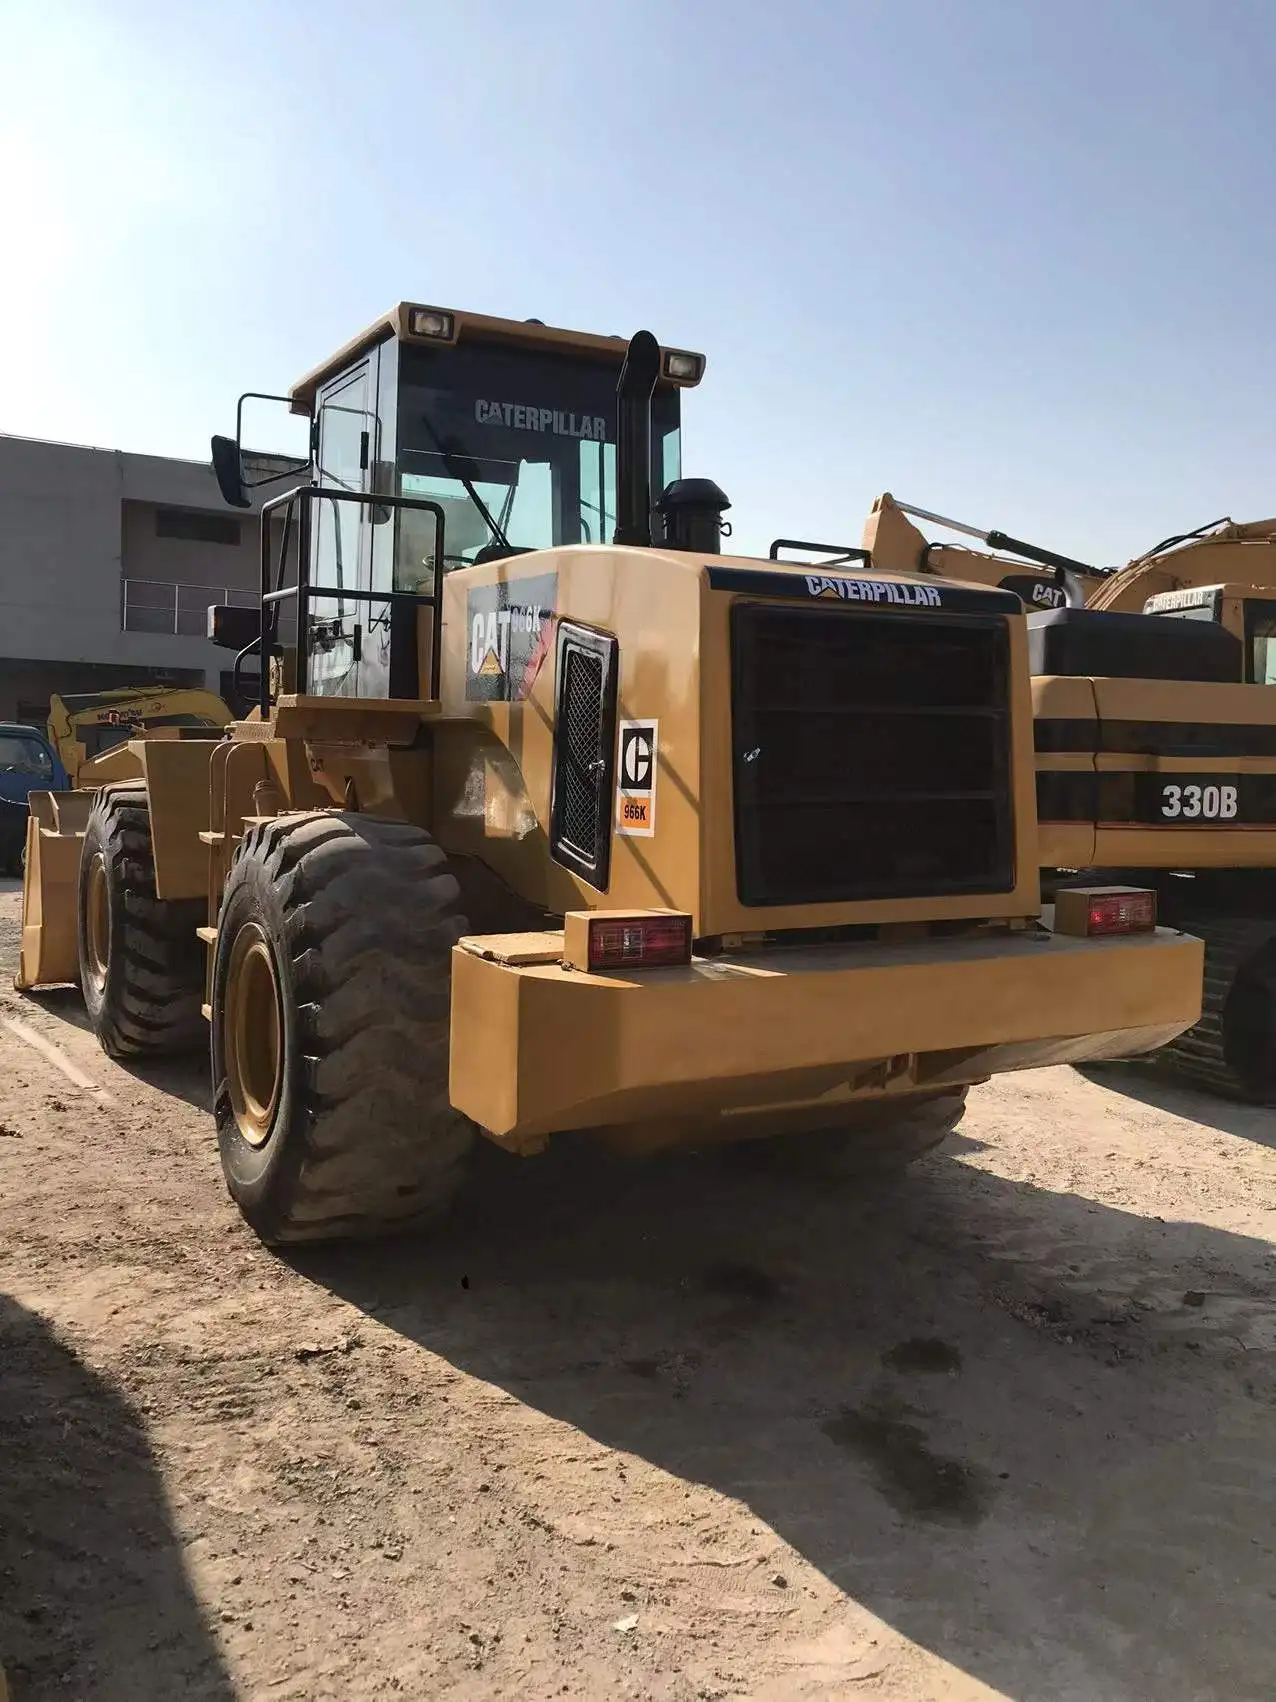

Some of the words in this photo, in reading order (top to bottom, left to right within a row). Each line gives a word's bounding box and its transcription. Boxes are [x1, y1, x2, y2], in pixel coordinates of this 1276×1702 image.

[474, 399, 606, 440] CATERPILLAR
[804, 576, 942, 607] CATERPILLAR
[1032, 584, 1063, 607] CAT
[471, 610, 511, 675] CAT
[624, 804, 647, 821] 966K
[1161, 785, 1238, 818] 330B
